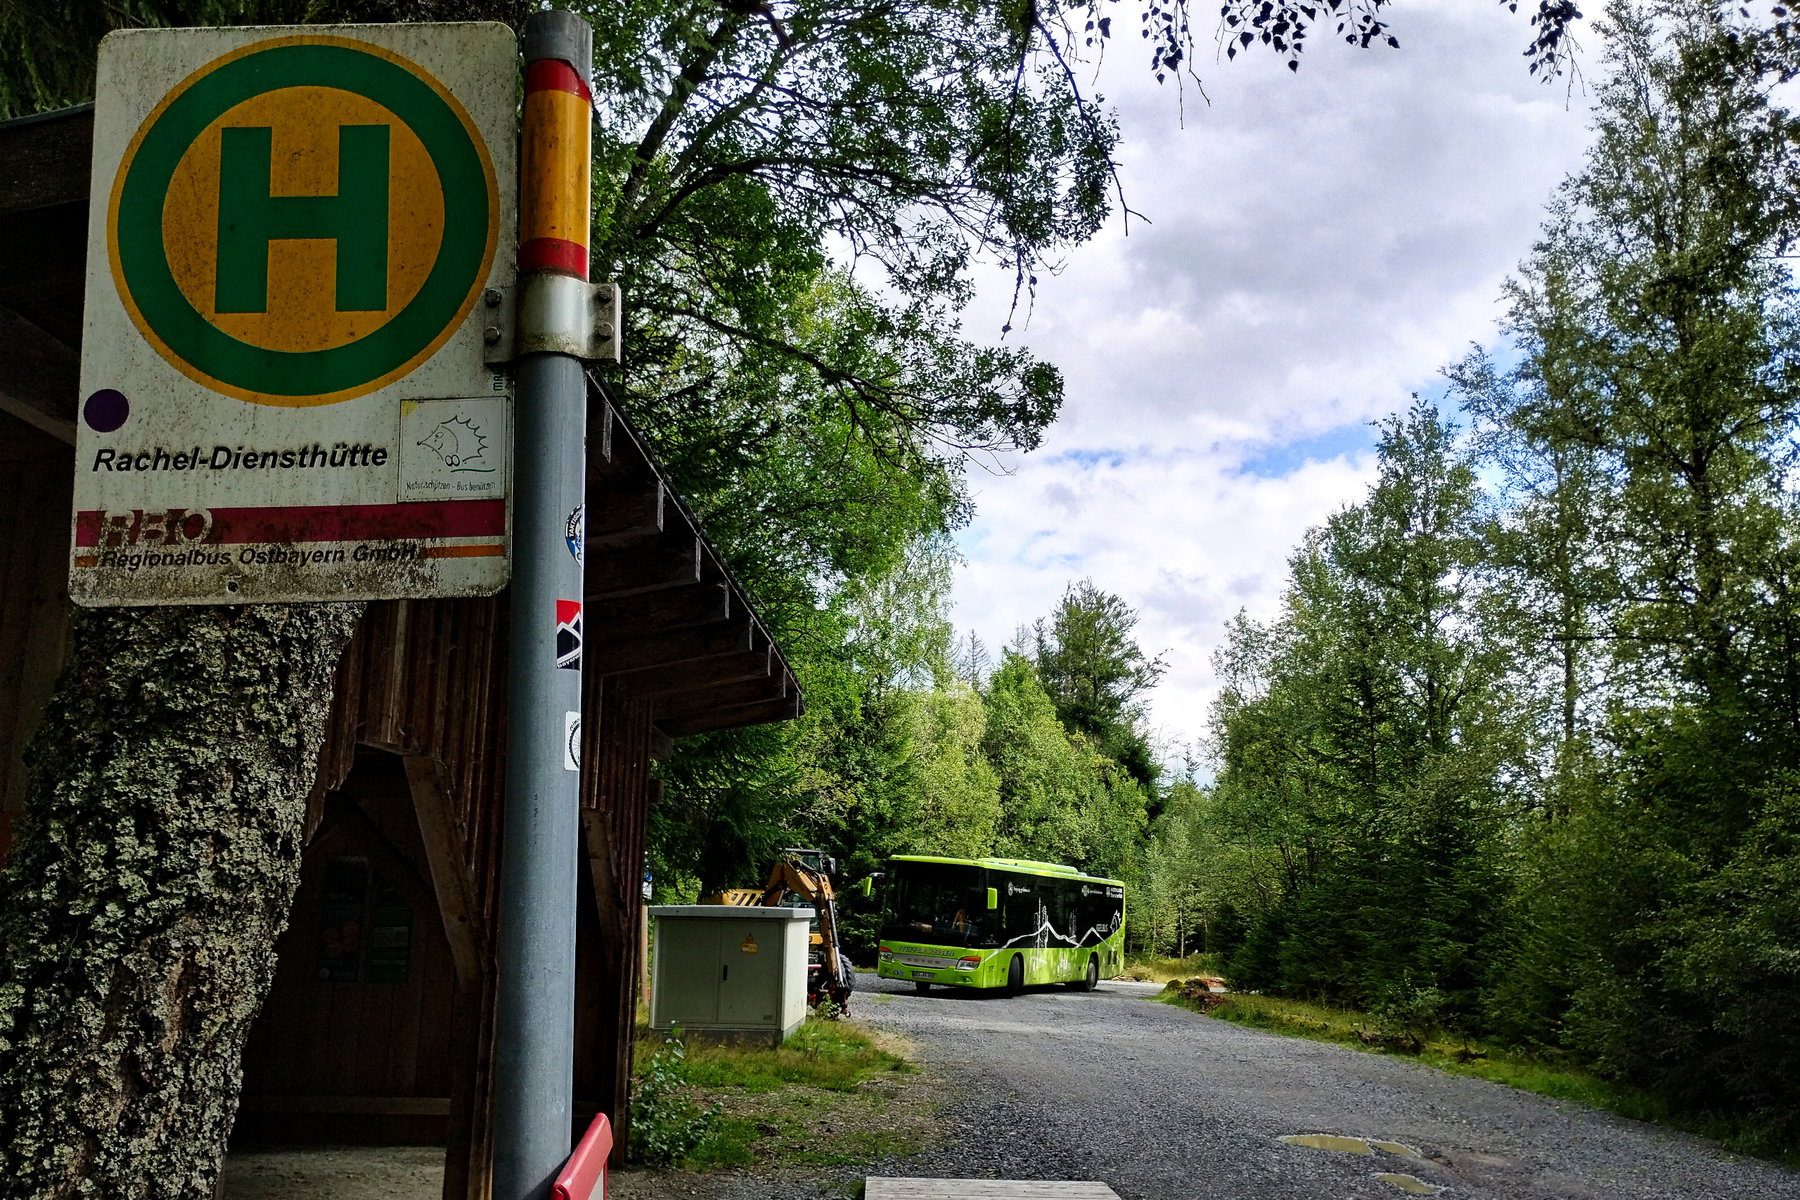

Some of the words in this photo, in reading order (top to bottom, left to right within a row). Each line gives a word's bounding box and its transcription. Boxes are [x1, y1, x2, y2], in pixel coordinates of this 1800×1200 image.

[214, 125, 390, 313] H
[93, 444, 387, 471] Rachel-Diensthütte
[101, 549, 231, 571] Regionalbus
[239, 547, 344, 567] Ostbayern
[353, 544, 418, 561] GmbH
